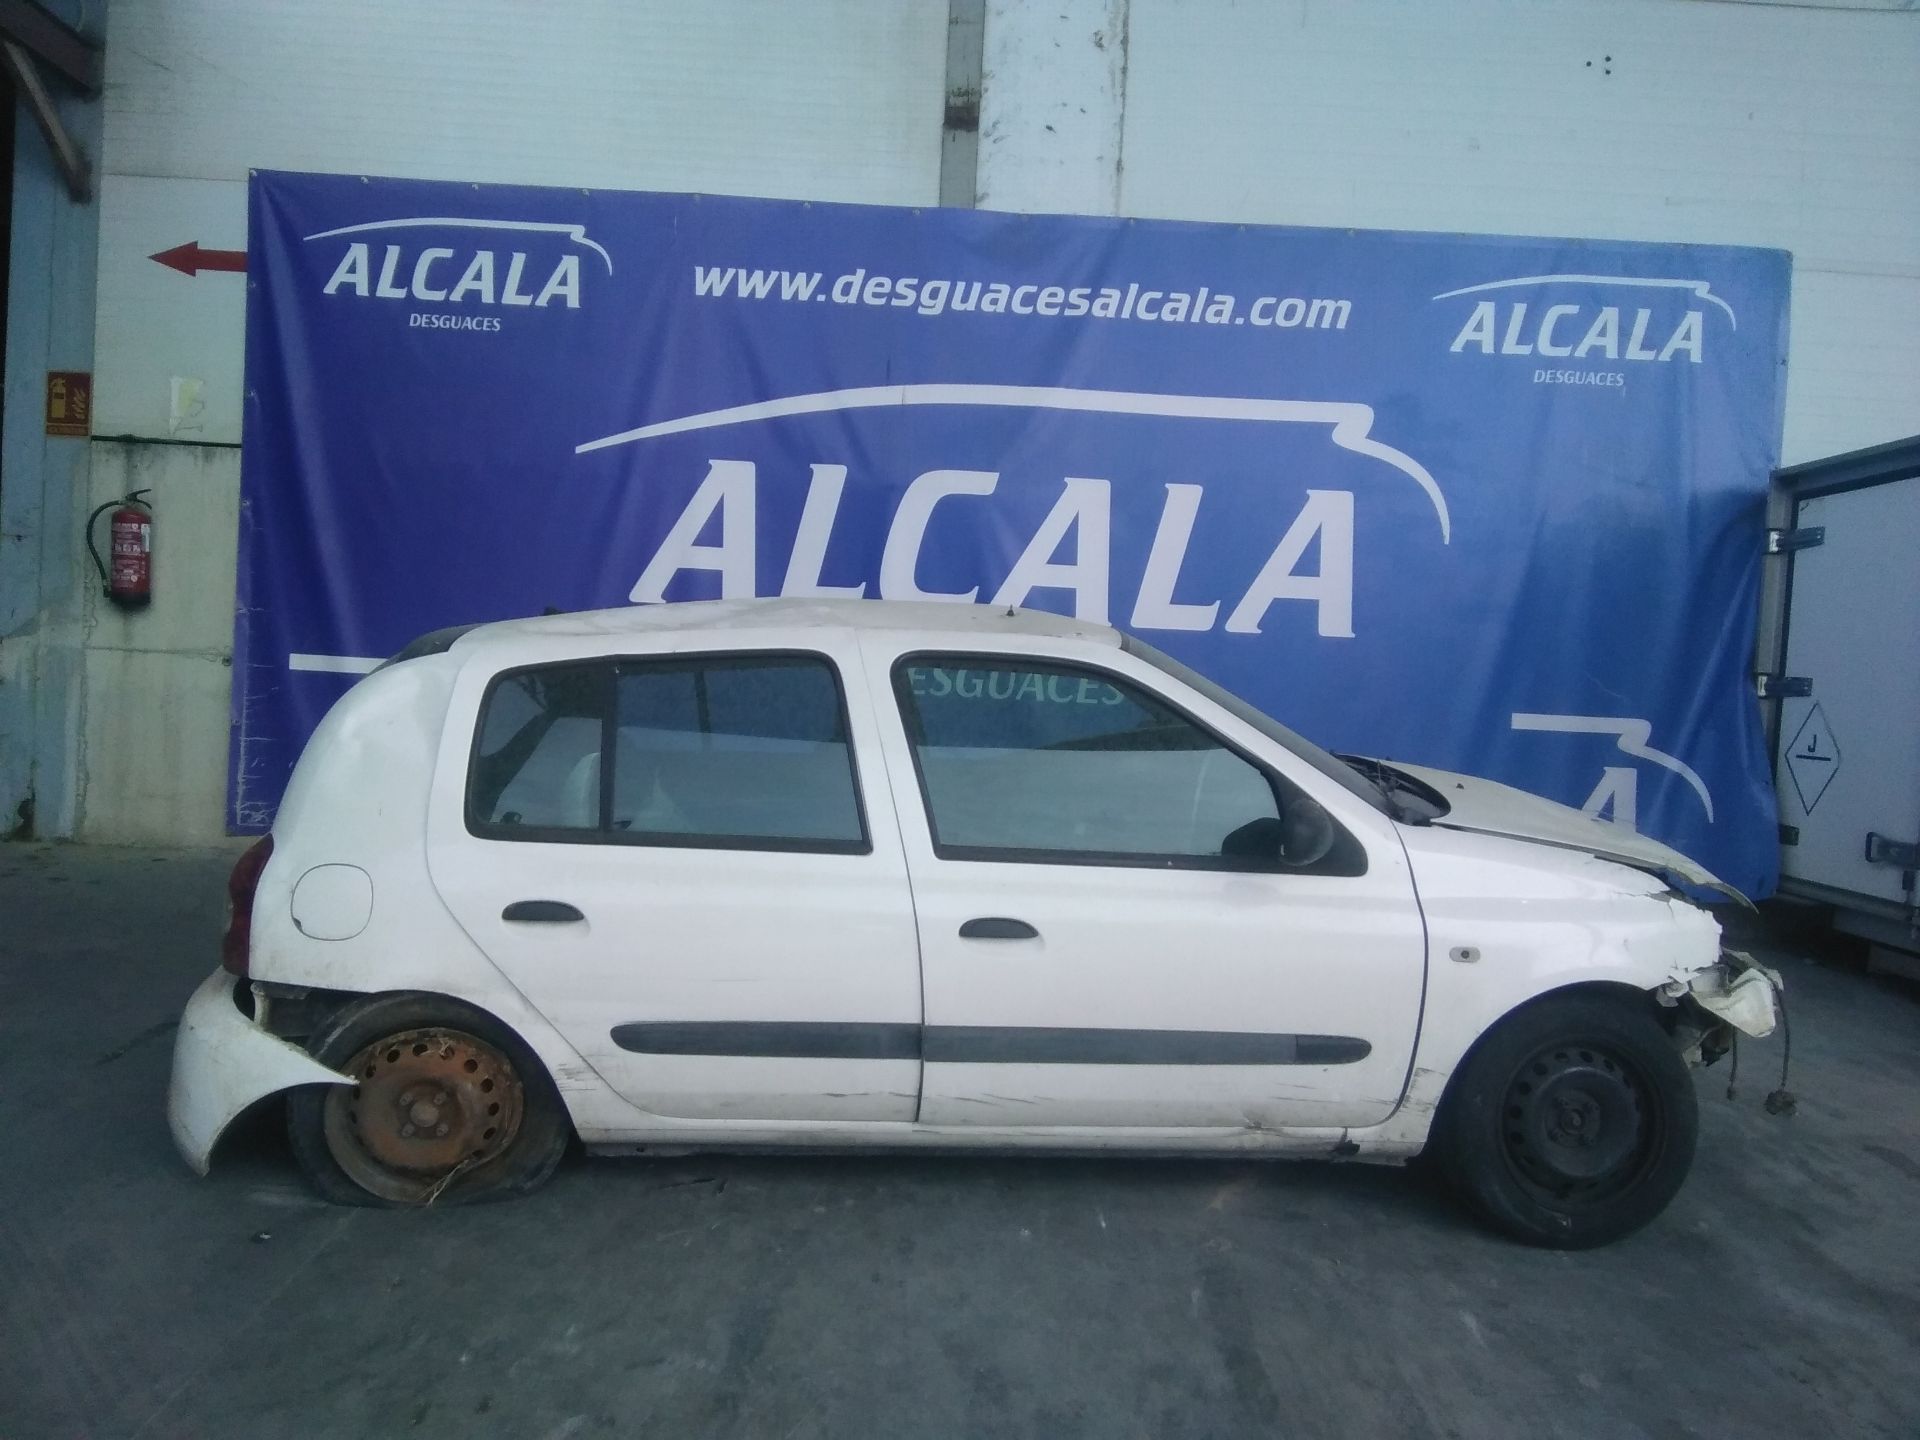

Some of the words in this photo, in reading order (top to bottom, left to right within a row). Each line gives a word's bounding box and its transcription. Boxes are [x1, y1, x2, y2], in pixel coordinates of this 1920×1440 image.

[323, 242, 581, 308] ALCALA
[694, 266, 1352, 329] www.desguacesalcala.com
[409, 312, 502, 332] DESGUACES
[1450, 301, 1703, 363] ALCALA
[1533, 369, 1625, 387] DESGUACES
[629, 459, 1355, 638] ALCALA
